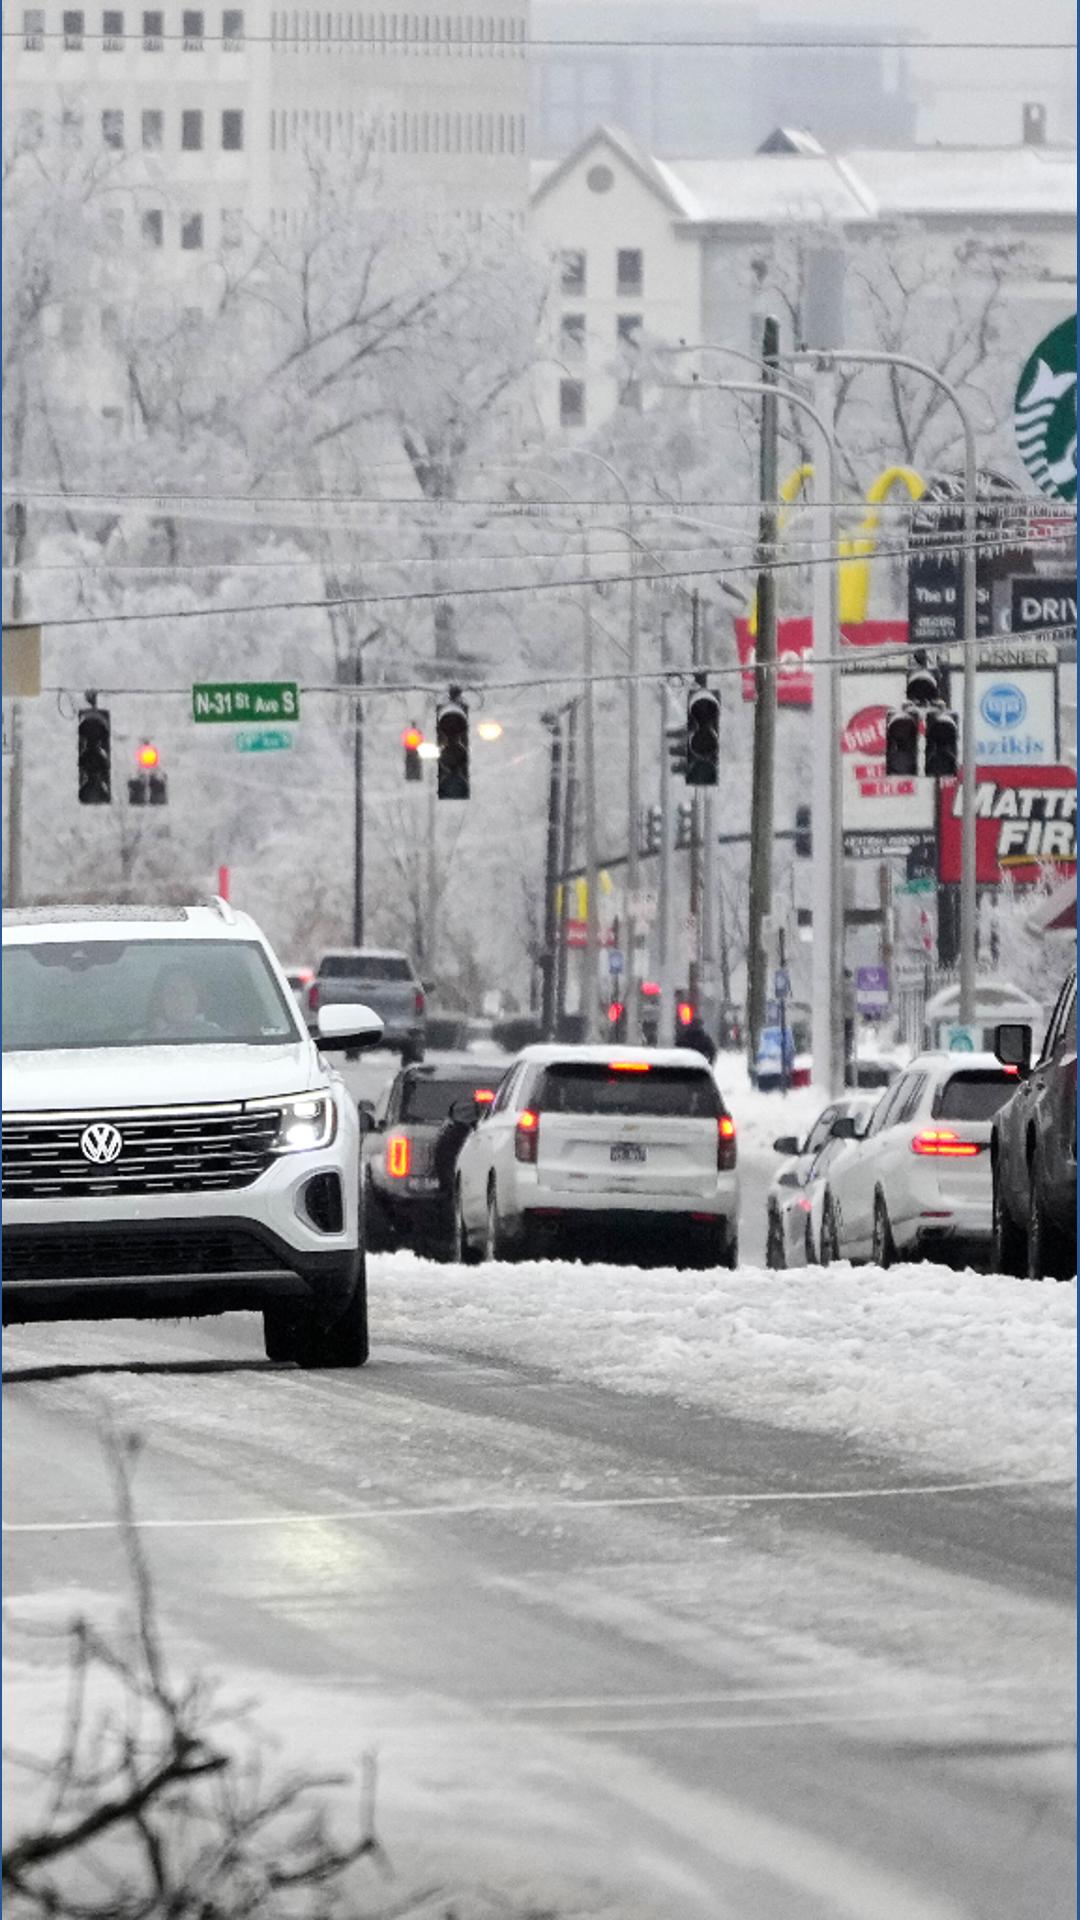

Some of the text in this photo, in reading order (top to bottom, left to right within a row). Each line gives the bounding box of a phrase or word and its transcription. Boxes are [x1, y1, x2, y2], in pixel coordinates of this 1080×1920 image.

[915, 587, 941, 603] The
[254, 695, 280, 713] Ave
[282, 690, 295, 713] S
